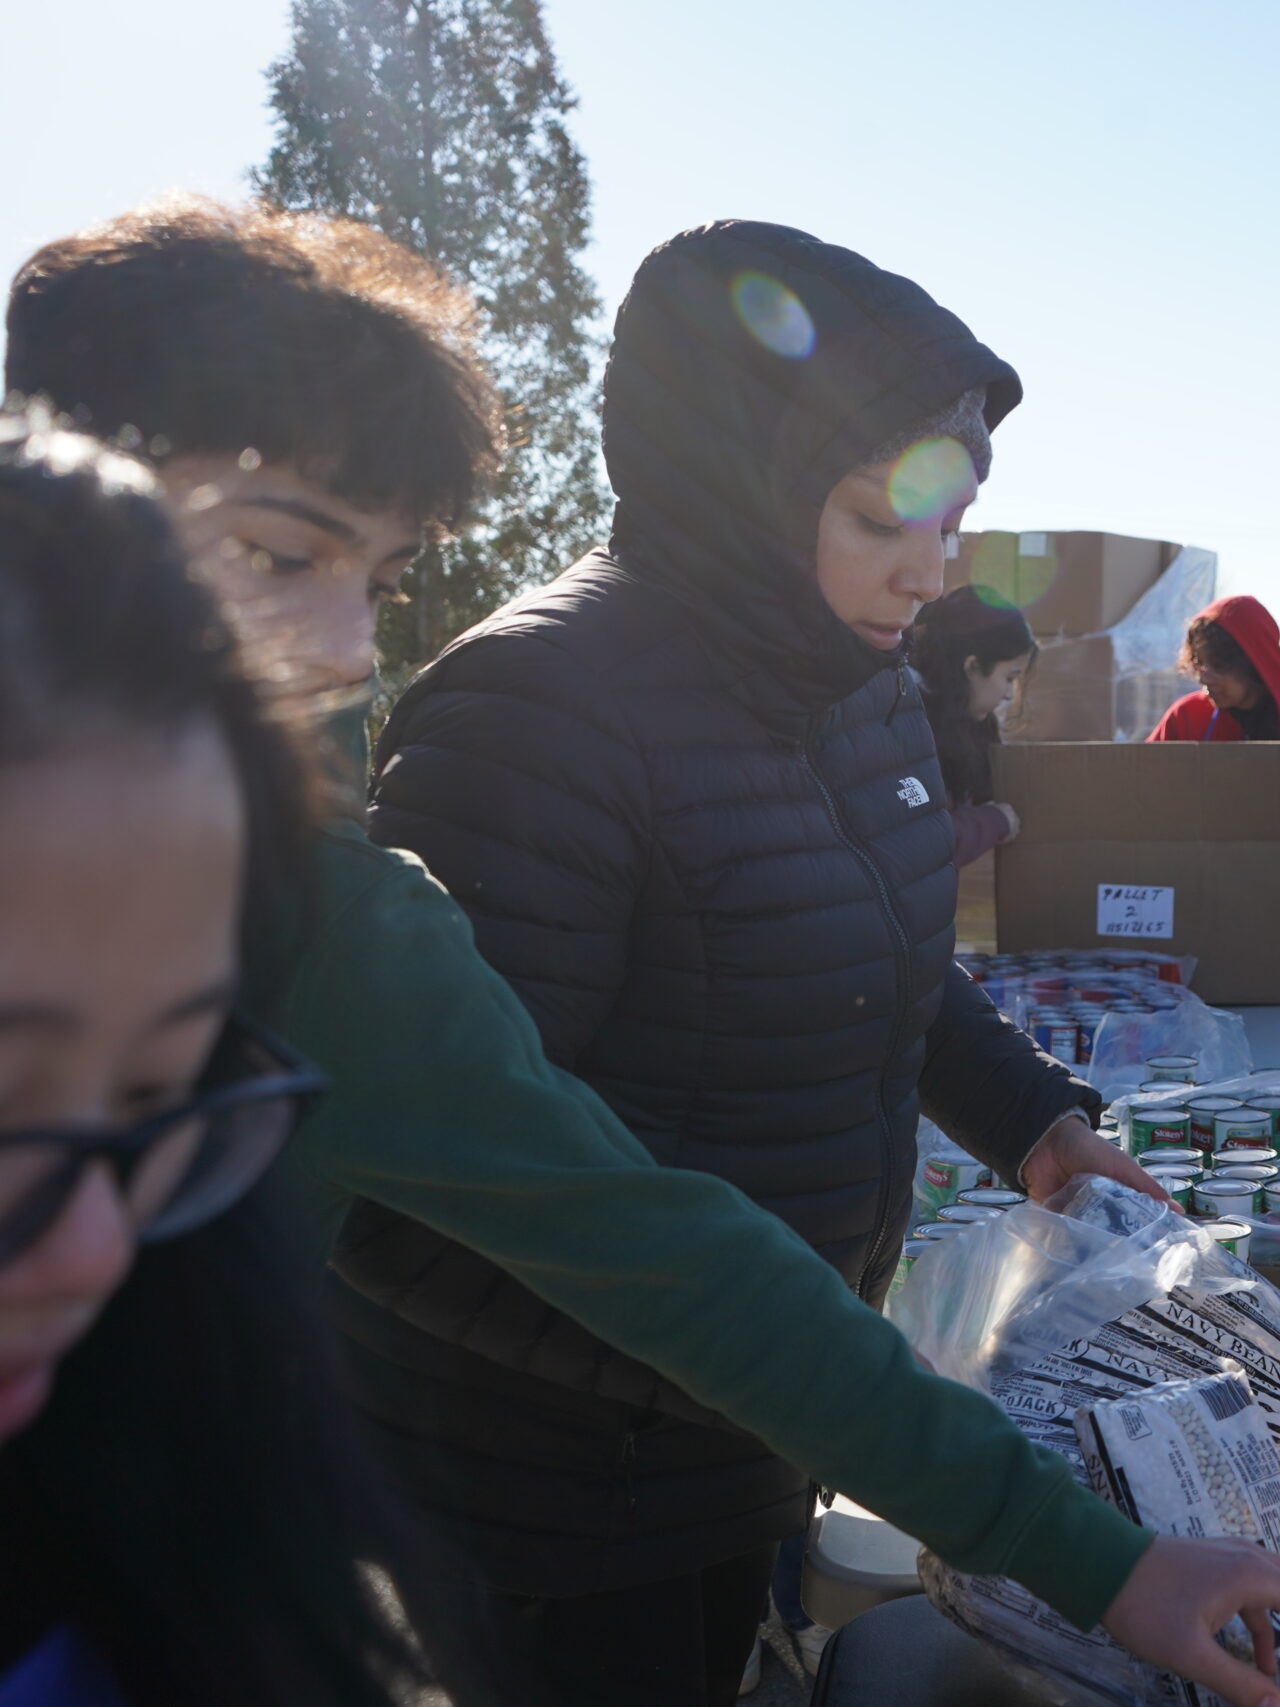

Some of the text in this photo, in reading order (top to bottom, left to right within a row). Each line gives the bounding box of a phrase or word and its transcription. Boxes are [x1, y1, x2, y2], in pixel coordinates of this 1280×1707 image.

[899, 777, 915, 788] THE
[897, 786, 921, 800] NORTH
[907, 796, 923, 808] FACE
[1125, 905, 1137, 918] 2
[1166, 1302, 1226, 1344] NAVY
